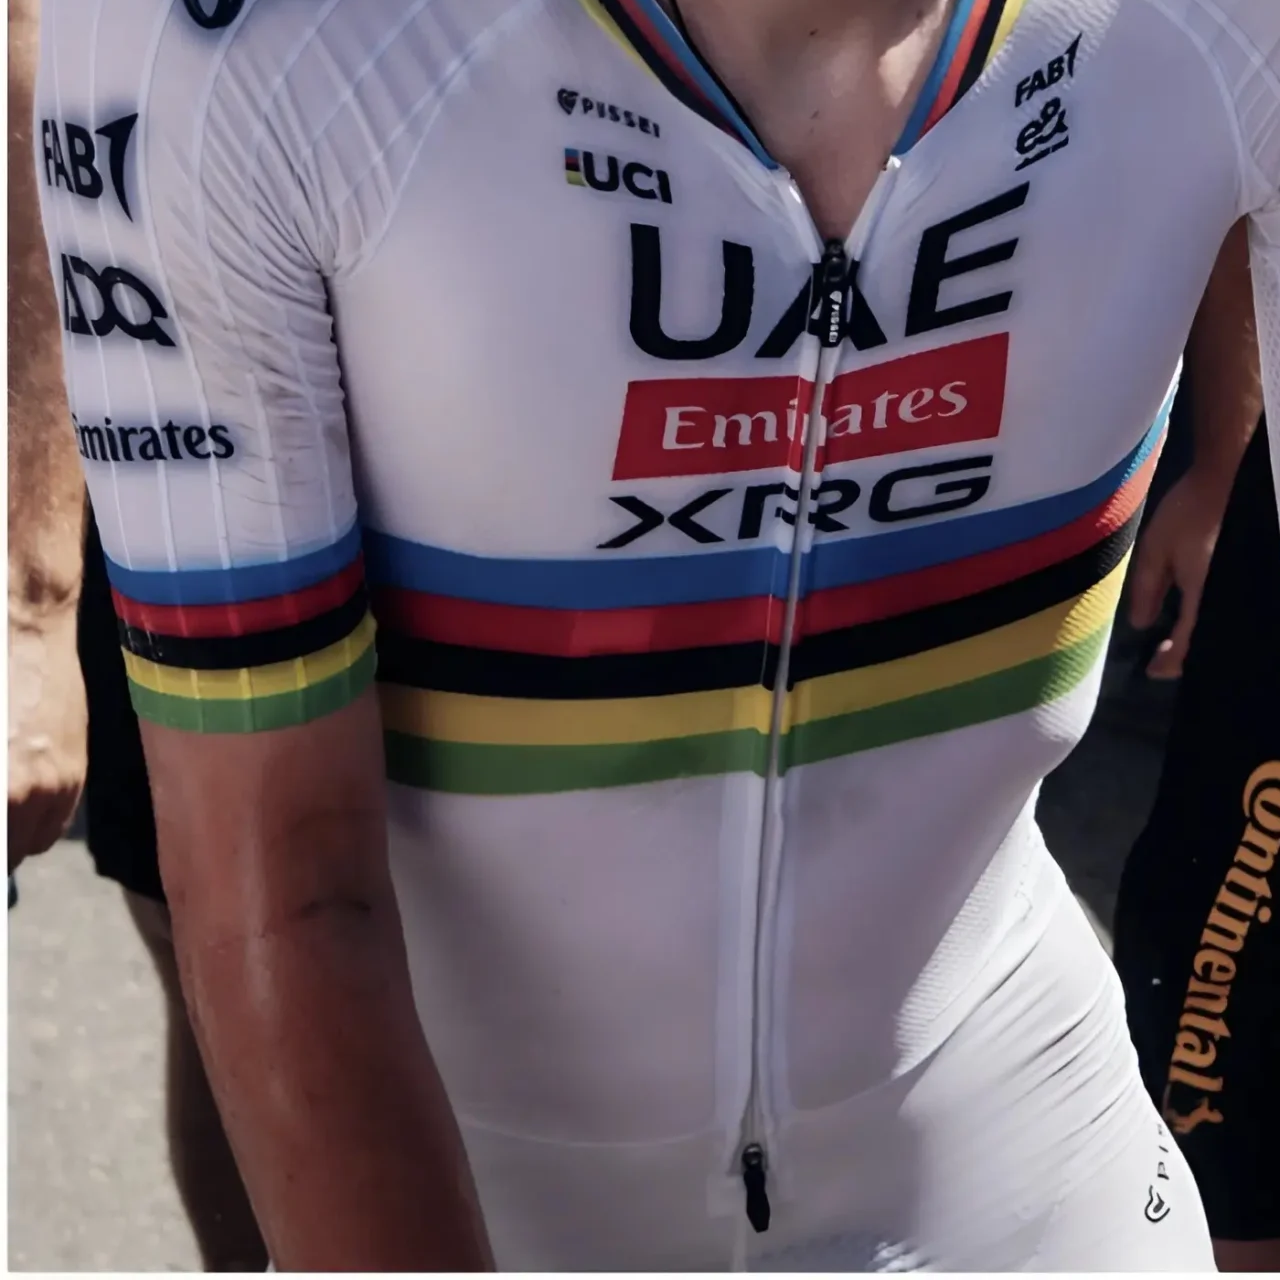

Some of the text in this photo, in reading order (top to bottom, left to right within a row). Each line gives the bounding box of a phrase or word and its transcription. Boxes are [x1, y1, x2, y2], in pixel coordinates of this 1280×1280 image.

[581, 96, 661, 138] PISSEI
[582, 150, 673, 204] UCI
[629, 181, 1031, 361] UAE
[72, 412, 235, 462] mirates
[595, 454, 993, 549] XRG
